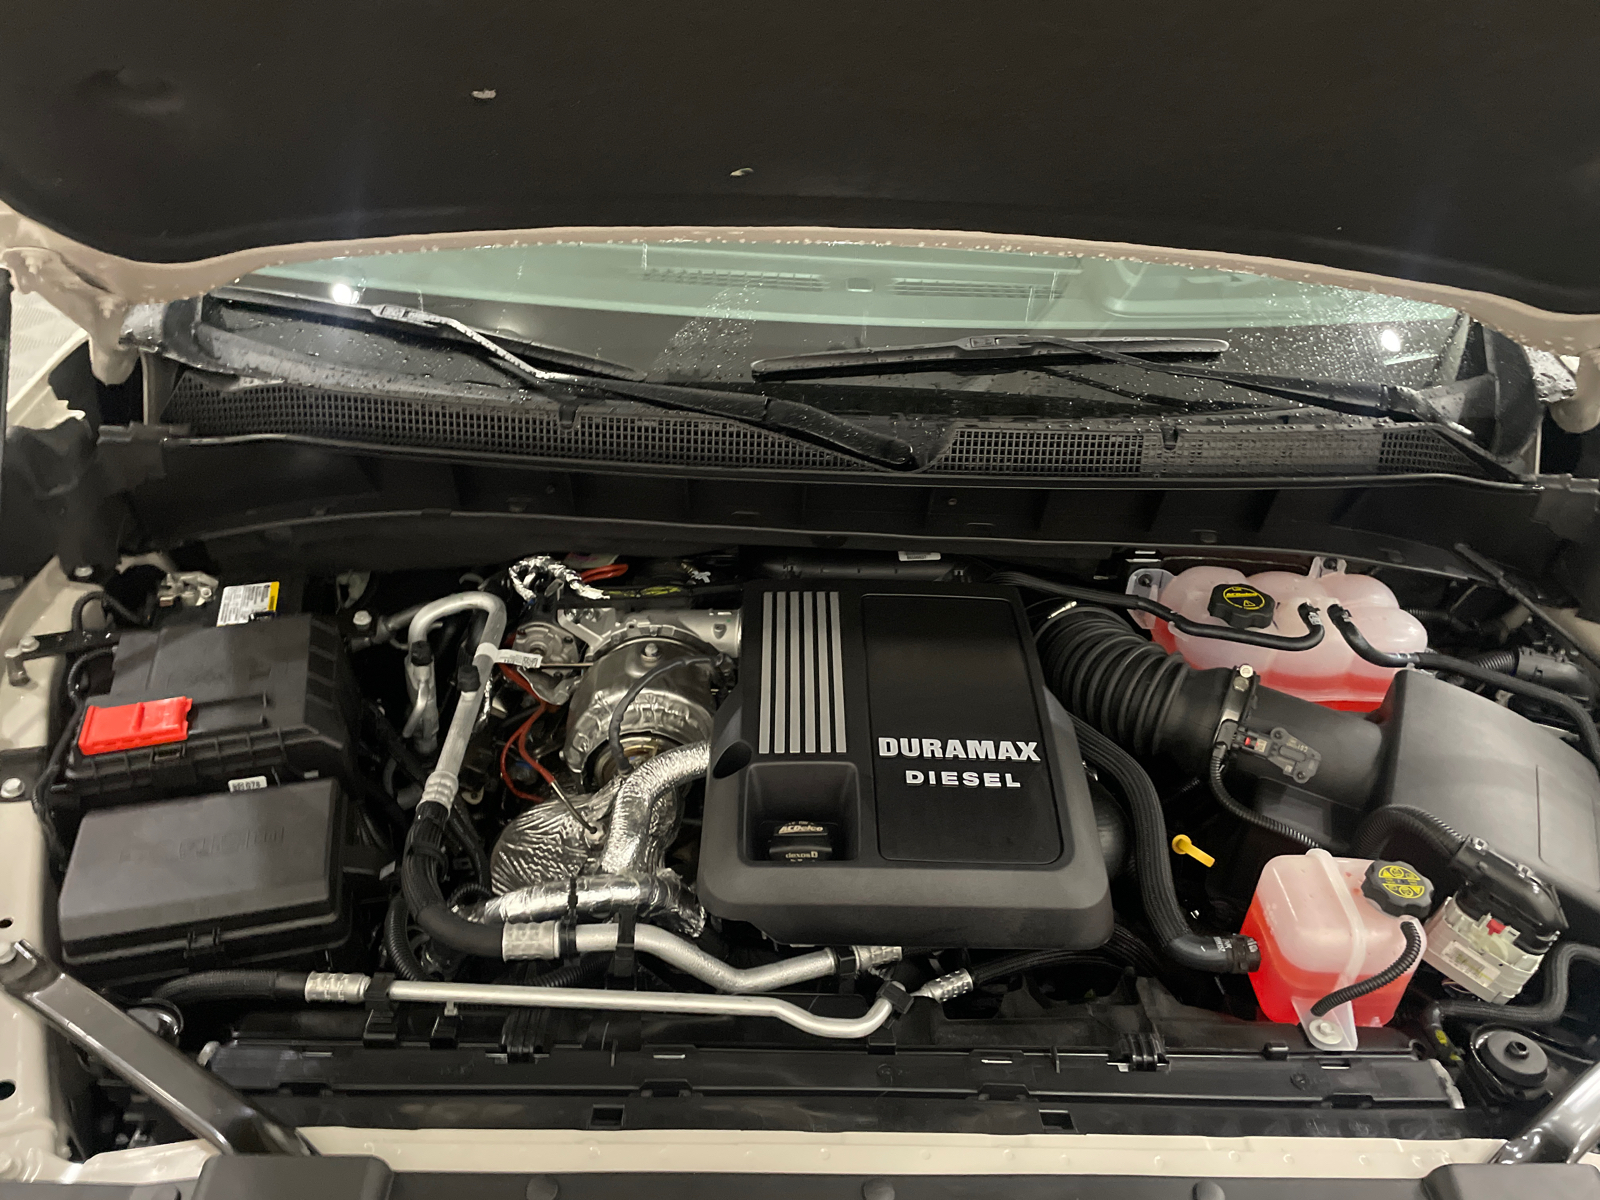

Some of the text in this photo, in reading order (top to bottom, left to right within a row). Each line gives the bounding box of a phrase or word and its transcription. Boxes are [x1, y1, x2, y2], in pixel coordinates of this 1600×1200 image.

[878, 737, 1041, 762] DURAMAX
[905, 769, 1021, 788] DIESEL
[778, 825, 824, 834] ACDelco
